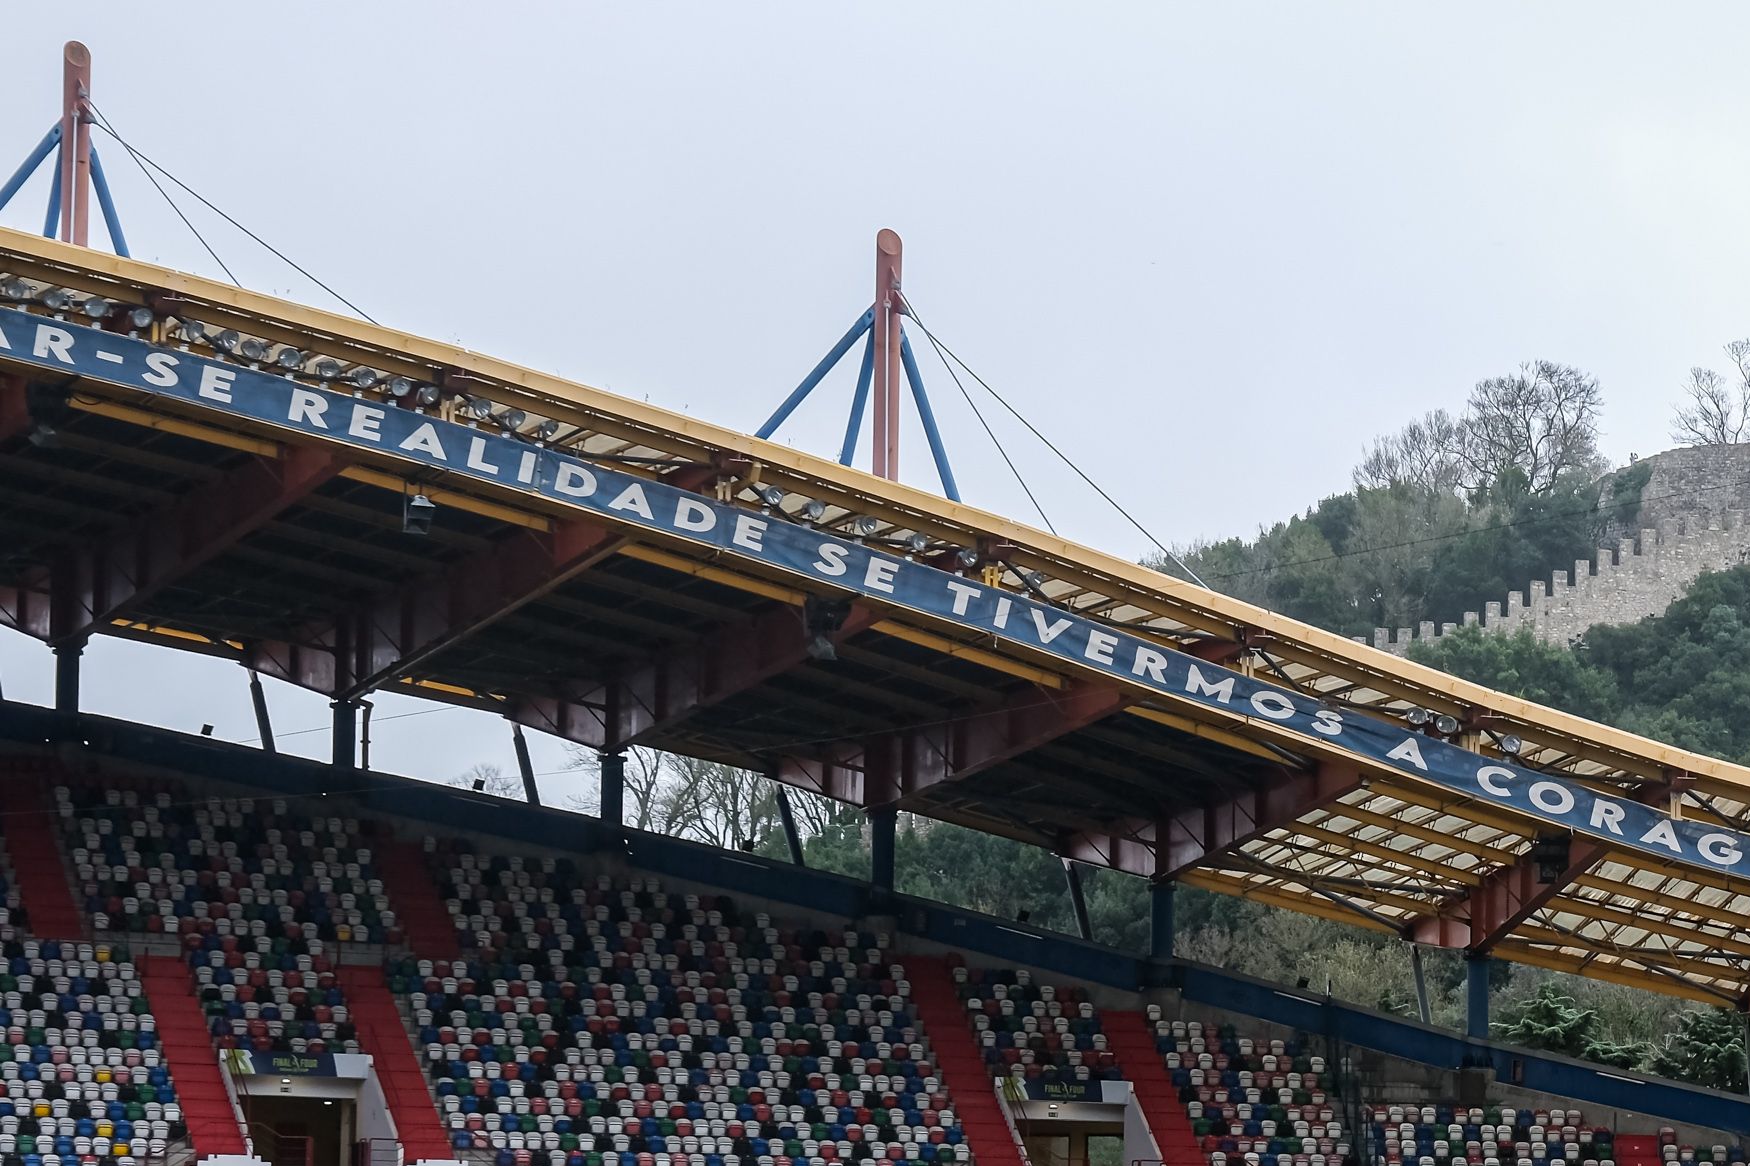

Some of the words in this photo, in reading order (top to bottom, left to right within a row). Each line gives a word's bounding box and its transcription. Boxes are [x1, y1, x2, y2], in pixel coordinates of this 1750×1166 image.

[0, 320, 237, 404] R-SE
[288, 388, 765, 555] REALIDADE
[812, 543, 900, 595] SE
[947, 580, 1343, 737] TIVERMOS
[1386, 737, 1429, 771] A
